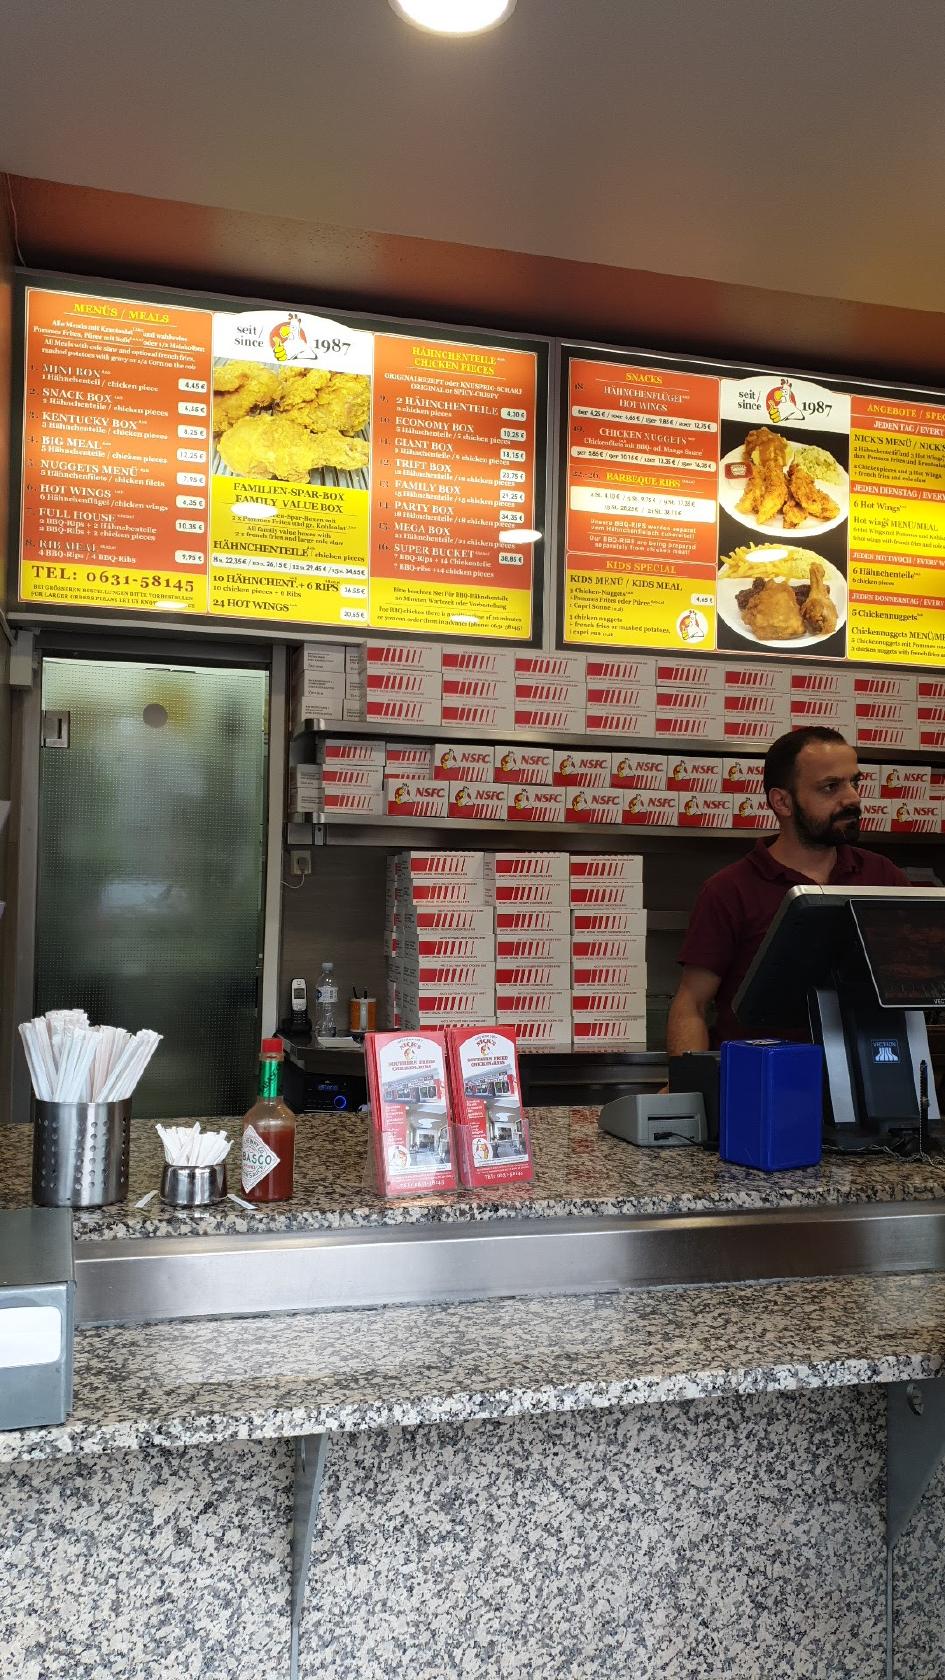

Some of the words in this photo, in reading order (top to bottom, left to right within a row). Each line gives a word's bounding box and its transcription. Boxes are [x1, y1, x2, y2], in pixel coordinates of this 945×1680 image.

[128, 311, 169, 323] MEALS
[234, 335, 264, 347] since
[314, 338, 351, 355] 1987
[412, 347, 496, 365] HÄHNCHENTEILE
[415, 358, 460, 370] CHICKEN
[461, 364, 494, 375] PIECES
[625, 372, 662, 384] SNACKS
[108, 381, 137, 390] chicken
[411, 384, 445, 393] ORIGINAL
[43, 388, 83, 400] SNACK
[87, 392, 111, 402] BOX
[604, 386, 682, 403] HÄHNCHENFLÜGEL
[405, 396, 498, 415] HÄHNCHENTEILE
[620, 400, 637, 408] HOT
[639, 402, 667, 411] WINGS
[738, 401, 761, 410] since
[802, 401, 832, 417] 1987
[867, 404, 916, 417] ANGEBOTE
[43, 412, 109, 426] KENTUCKY
[112, 419, 137, 429] BOX
[396, 417, 449, 430] ECONOMY
[452, 423, 475, 432] BOX
[113, 429, 142, 438] chicken
[874, 421, 899, 429] JEDEN
[900, 424, 914, 432] TAG
[921, 426, 944, 436] EVERY
[600, 428, 641, 440] CHICKEN
[644, 433, 686, 444] NUGGETS
[855, 434, 883, 444] NICK'S
[886, 438, 912, 447] MENÜ
[42, 436, 63, 445] BIG
[66, 438, 102, 449] MEAL
[395, 438, 429, 449] GIANT
[432, 442, 453, 452] BOX
[112, 452, 142, 461] chicken
[40, 459, 99, 473] NUGGETS
[102, 465, 137, 476] MENÜ
[395, 459, 426, 469] TRIFT
[430, 462, 452, 472] BOX
[115, 476, 143, 485] chicken
[145, 478, 165, 487] filets
[606, 472, 658, 485] BARBEQUE
[659, 479, 680, 488] RIBS
[40, 484, 66, 494] HOT
[70, 486, 111, 498] WINGS
[234, 483, 344, 501] FAMILIEN-SPAR-BOX
[395, 480, 436, 492] FAMILY
[439, 484, 461, 494] BOX
[854, 484, 879, 493] JEDEN
[880, 487, 917, 497] DIENSTAG
[235, 495, 277, 507] FAMILY
[283, 500, 319, 510] VALUE
[321, 504, 343, 513] BOX
[395, 501, 429, 511] PARTY
[432, 505, 454, 514] BOX
[877, 503, 900, 513] Wings
[40, 508, 70, 519] FULL
[74, 511, 115, 522] HOUSE
[854, 516, 867, 524] Hot
[395, 523, 425, 533] MEGA
[429, 527, 450, 535] BOX
[214, 540, 308, 557] HÄHNCHENTEILE
[344, 554, 364, 562] pieces
[394, 544, 429, 554] SUPER
[432, 547, 475, 558] BUCKET
[606, 561, 632, 570] KIDS
[634, 564, 676, 574] SPECIAL
[860, 568, 914, 579] Hähnchenteile
[32, 566, 77, 580] TEL:
[87, 571, 194, 592] 0631-58145
[570, 575, 593, 584] KIDS
[596, 577, 623, 585] MENÜ
[656, 582, 682, 591] MEAL
[315, 583, 339, 592] RIPS
[213, 599, 225, 607] 24
[227, 599, 250, 609] HOT
[252, 602, 289, 612] WINGS
[858, 610, 917, 621] Chickennuggets
[852, 627, 907, 639] Chickennuggets
[461, 753, 490, 763] NSFC
[521, 755, 549, 765] NSFC
[579, 760, 607, 769] NSFC
[635, 762, 663, 772] NSFC
[691, 765, 718, 774] NSFC
[747, 766, 765, 775] NSF
[904, 773, 927, 782] NSFC
[416, 788, 445, 797] NSFC
[475, 790, 504, 800] NSFC
[534, 793, 562, 803] NSFC
[592, 795, 619, 805] NSFC
[648, 798, 676, 808] NSFC
[703, 800, 729, 809] NSFC
[757, 801, 771, 810] NS
[864, 805, 888, 814] NSFC
[914, 807, 938, 815] NSFC
[243, 1151, 272, 1165] BASCO
